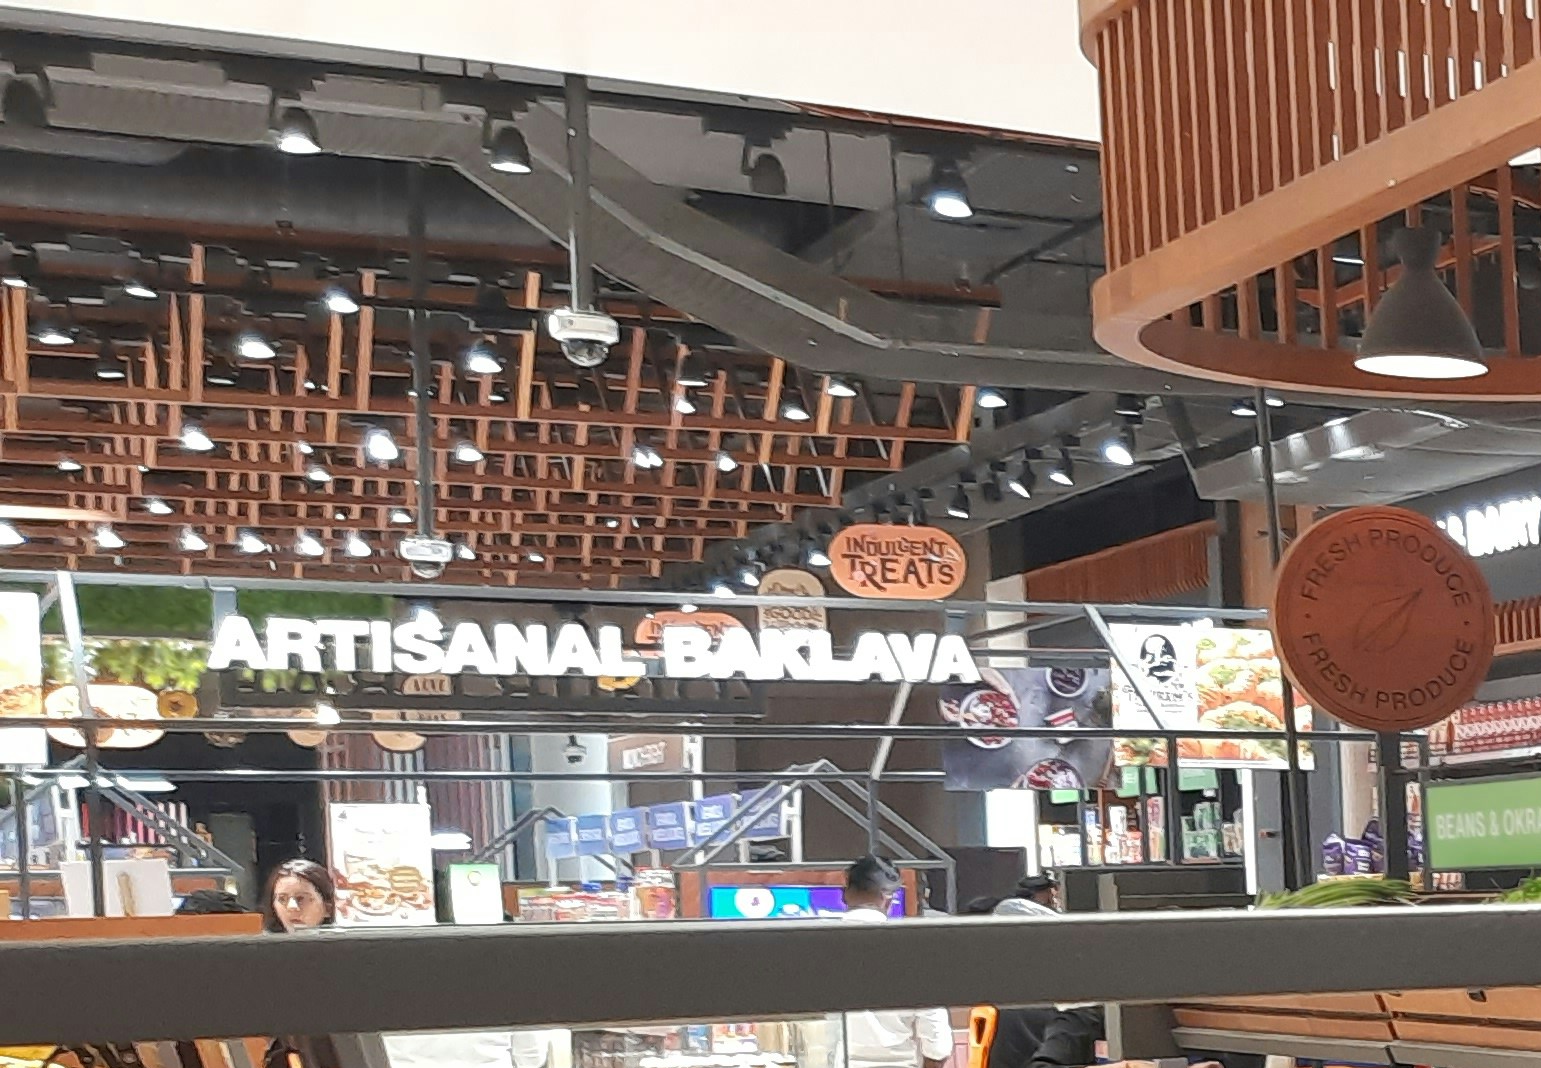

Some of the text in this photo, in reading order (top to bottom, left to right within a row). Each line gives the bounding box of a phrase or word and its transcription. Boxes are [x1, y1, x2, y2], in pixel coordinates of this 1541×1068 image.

[841, 553, 955, 592] TREATS
[845, 535, 948, 558] INDULGENT
[1301, 528, 1473, 607] FRESH PRODUCE
[207, 616, 982, 682] ARTISANAL BAKLAVA
[1302, 631, 1475, 711] FRESH PRODUCE
[1436, 810, 1486, 840] BEANS
[1489, 809, 1499, 836] &
